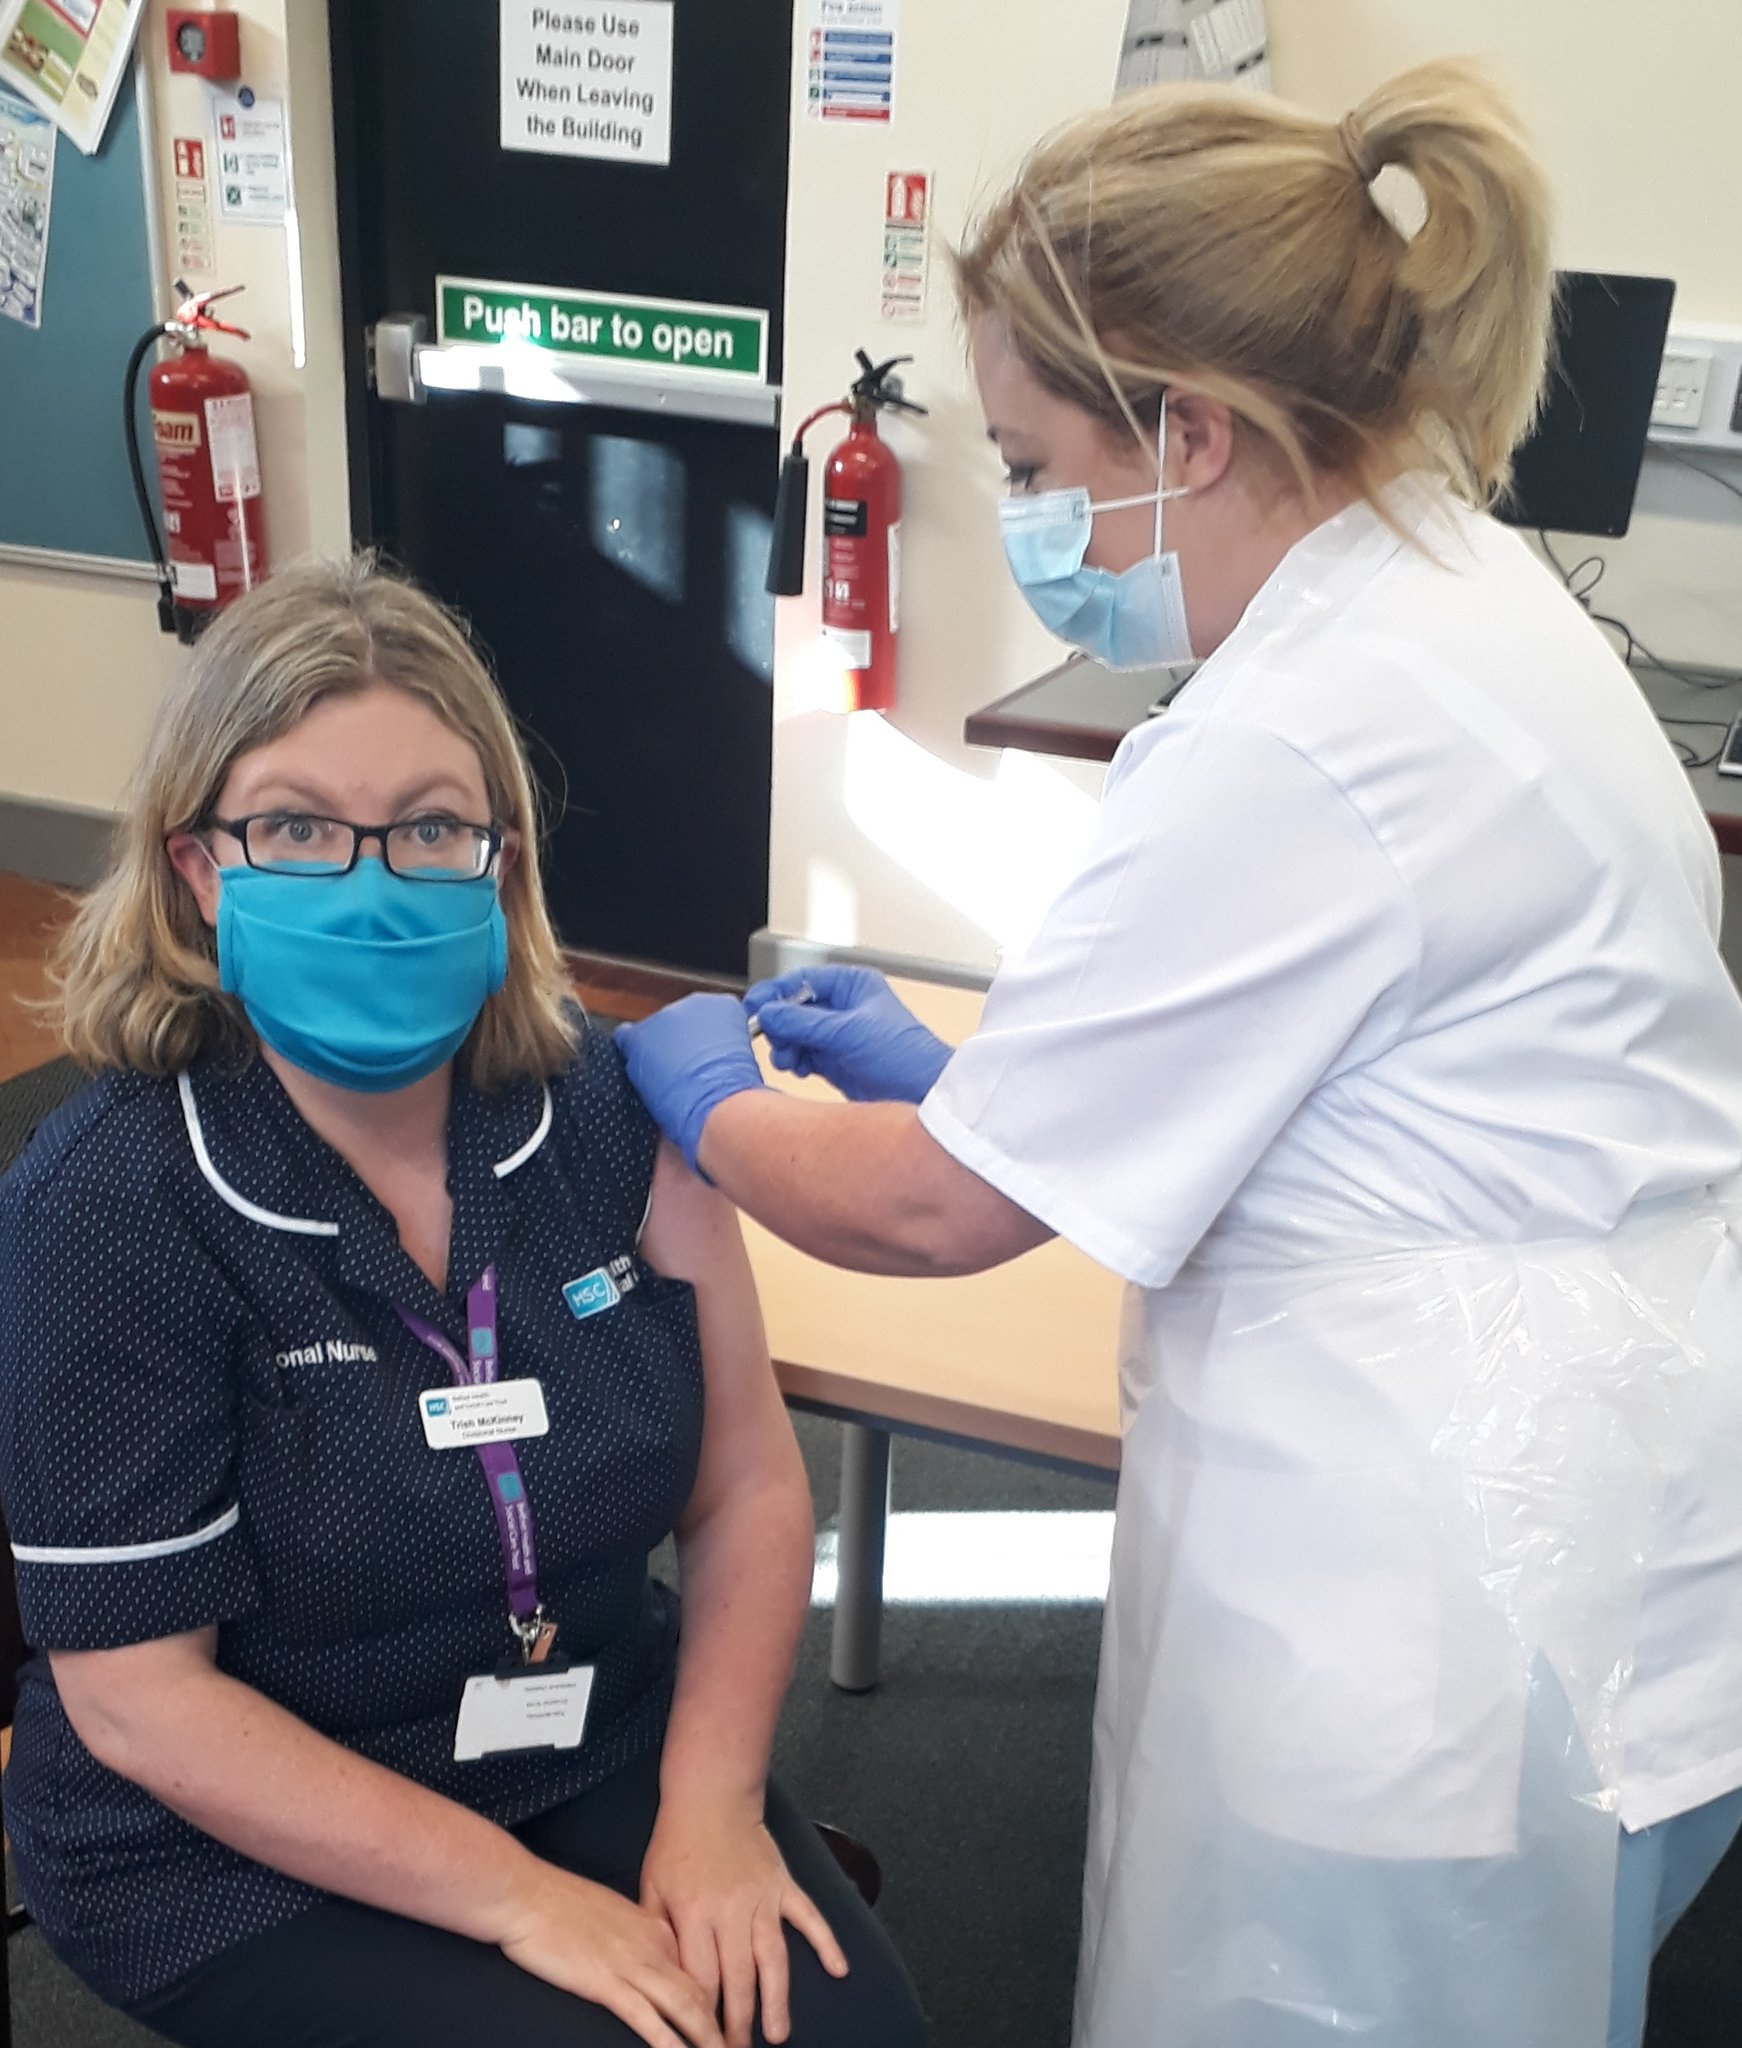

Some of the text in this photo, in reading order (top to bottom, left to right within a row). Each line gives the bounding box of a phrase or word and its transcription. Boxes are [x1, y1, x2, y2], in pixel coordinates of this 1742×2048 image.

[532, 7, 640, 37] Please Use
[536, 43, 636, 73] Main Door
[516, 77, 653, 116] When Leaving
[527, 114, 643, 150] the Building
[463, 296, 734, 362] Push bar to open
[571, 1281, 606, 1308] HSC
[477, 1414, 524, 1427] McKinney
